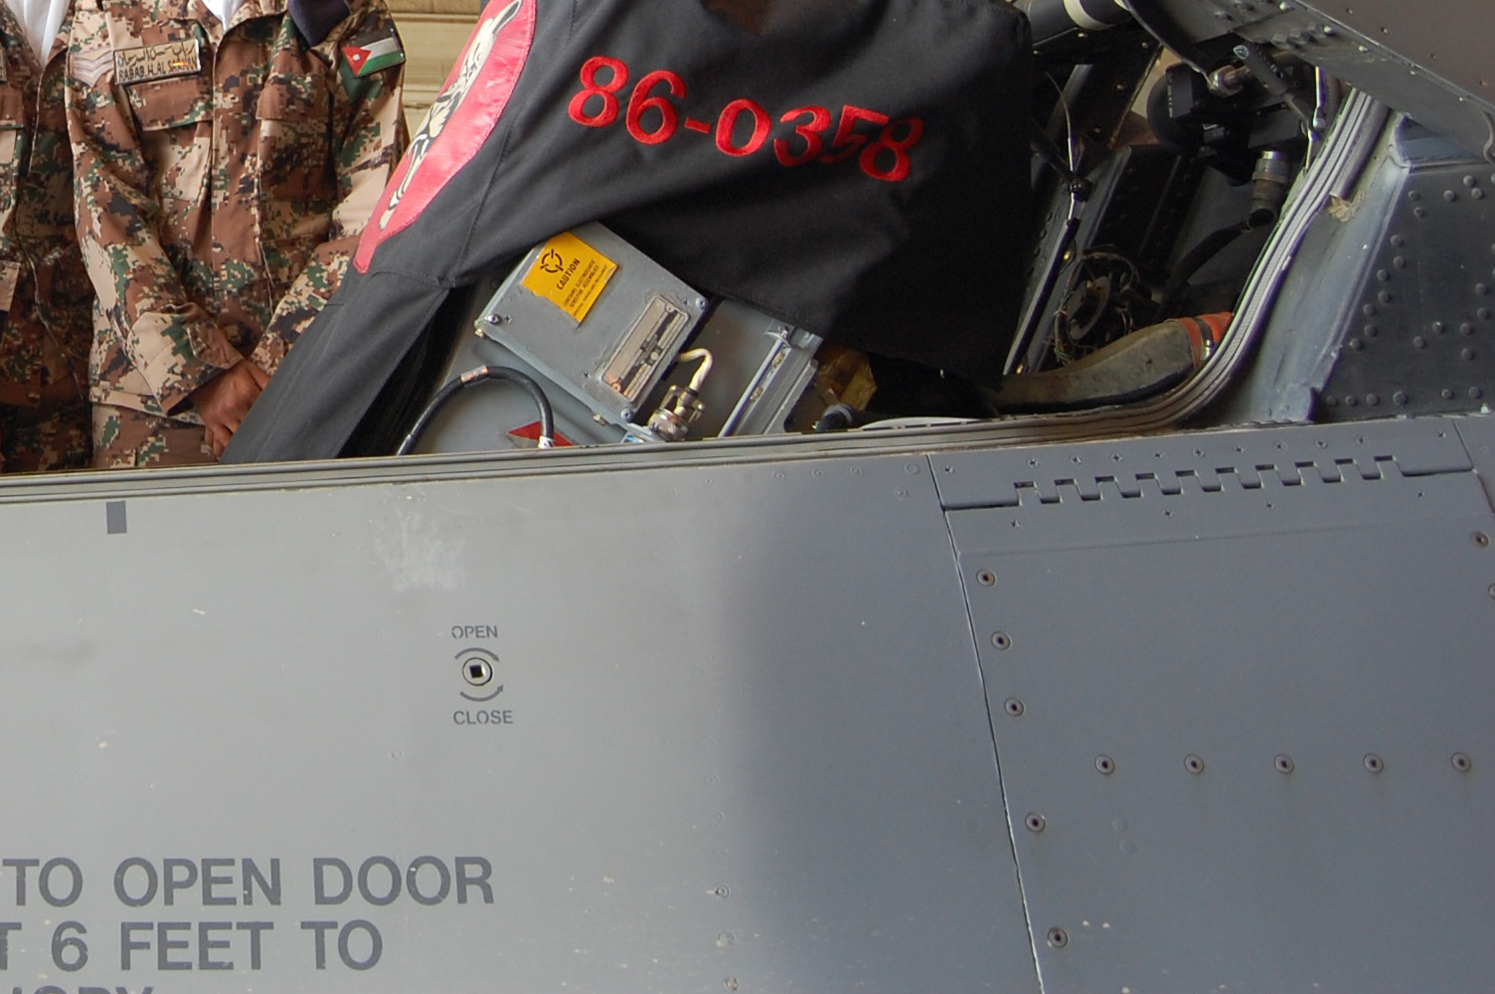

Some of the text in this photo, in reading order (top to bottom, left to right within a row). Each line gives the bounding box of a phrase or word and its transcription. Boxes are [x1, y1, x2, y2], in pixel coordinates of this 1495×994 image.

[568, 56, 924, 181] 86-0358
[556, 257, 580, 291] CAUTION
[451, 625, 498, 639] OPEN
[453, 710, 513, 725] CLOSE
[2, 857, 83, 908] TO
[113, 857, 282, 908] OPEN
[312, 856, 494, 907] DOOR
[51, 920, 89, 972] 6
[120, 921, 274, 971] FEET
[300, 919, 383, 971] TO
